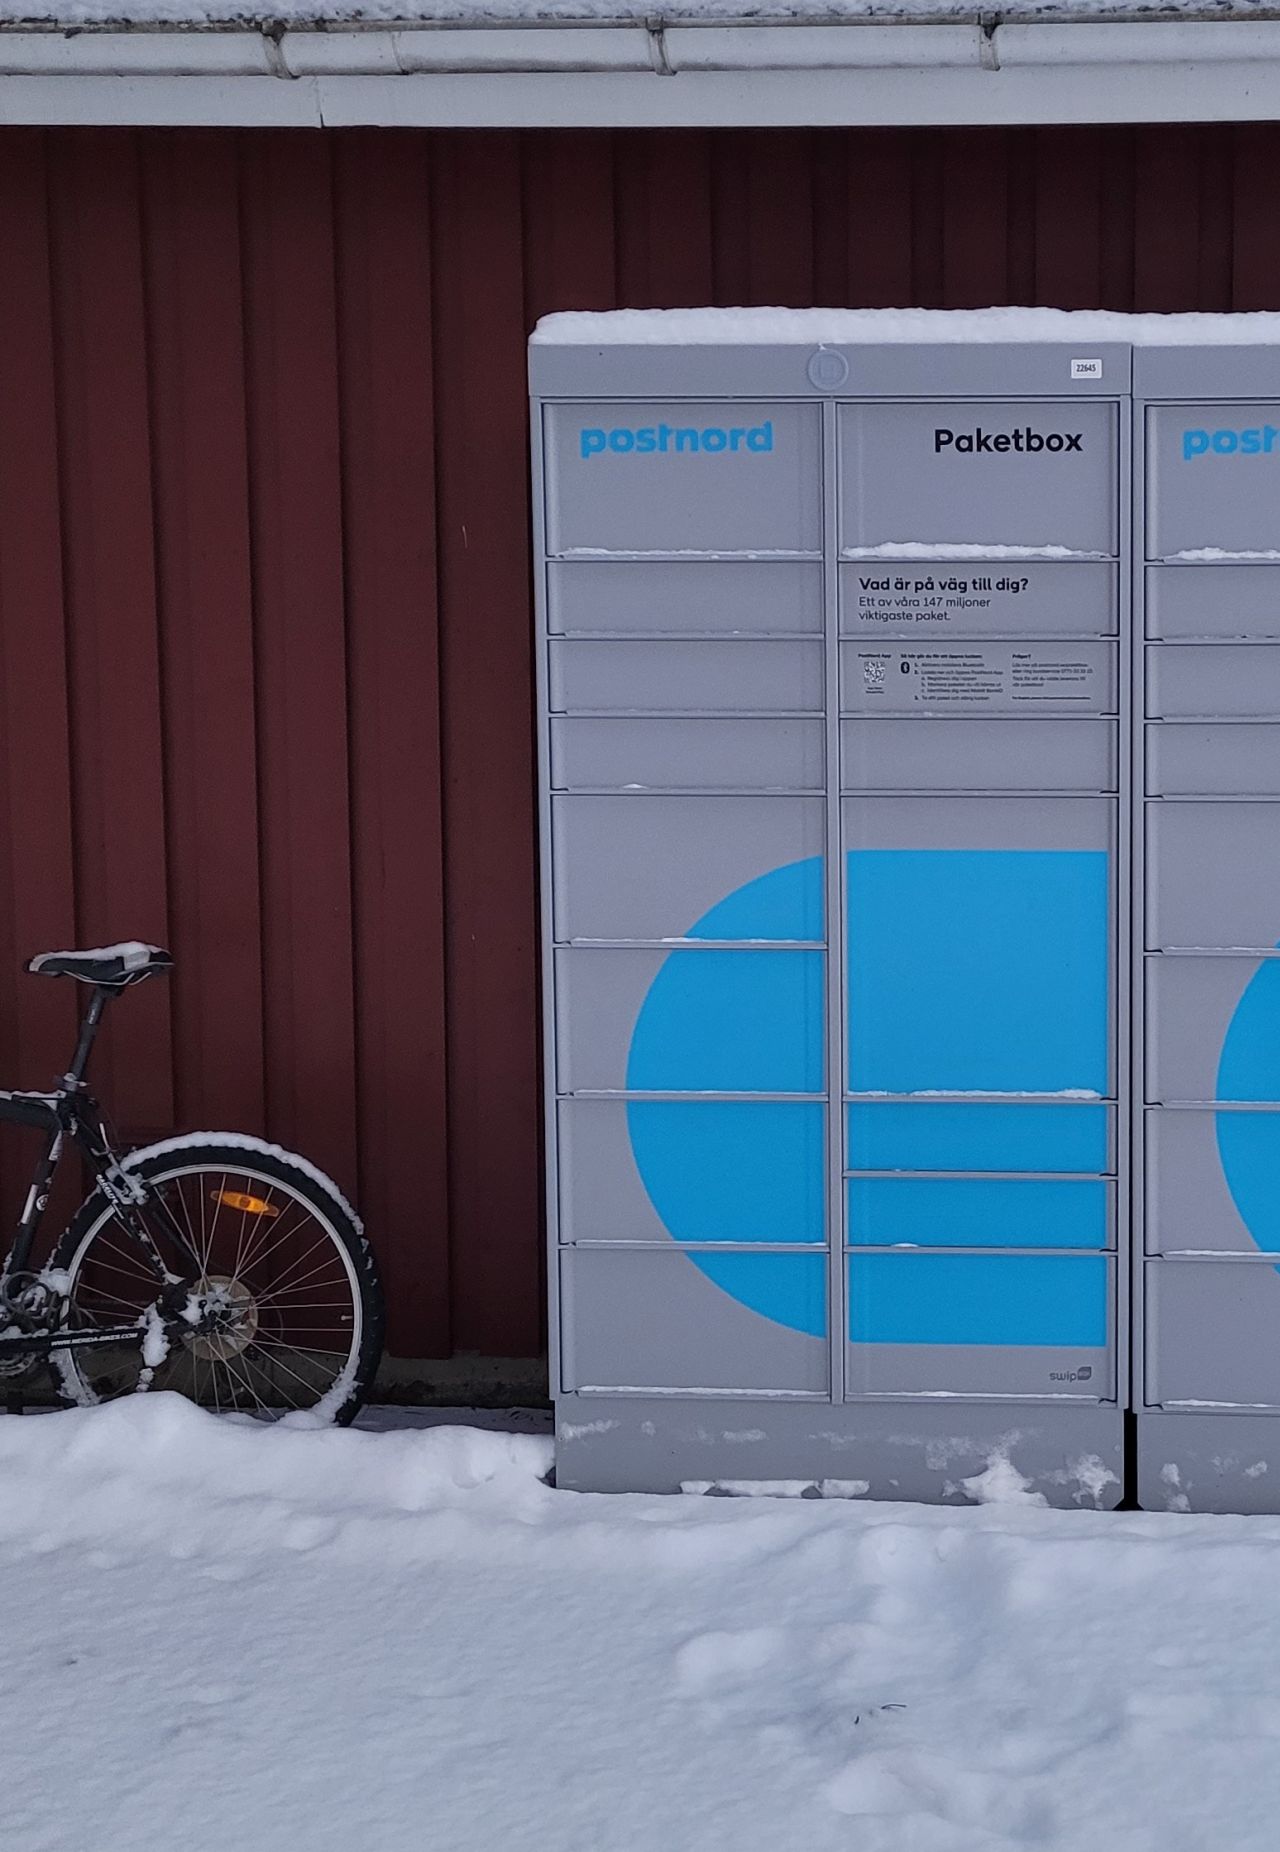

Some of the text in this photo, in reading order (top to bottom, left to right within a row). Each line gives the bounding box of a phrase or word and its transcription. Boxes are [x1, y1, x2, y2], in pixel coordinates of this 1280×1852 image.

[1076, 363, 1097, 372] 22645
[580, 421, 773, 459] postnord
[934, 427, 1083, 453] Paketbox
[859, 576, 1028, 593] Vad är på väg till dig?
[859, 596, 991, 608] Ett av våra 147 miljoner
[859, 611, 951, 622] viktigaste paket.
[1049, 1370, 1077, 1383] swip
